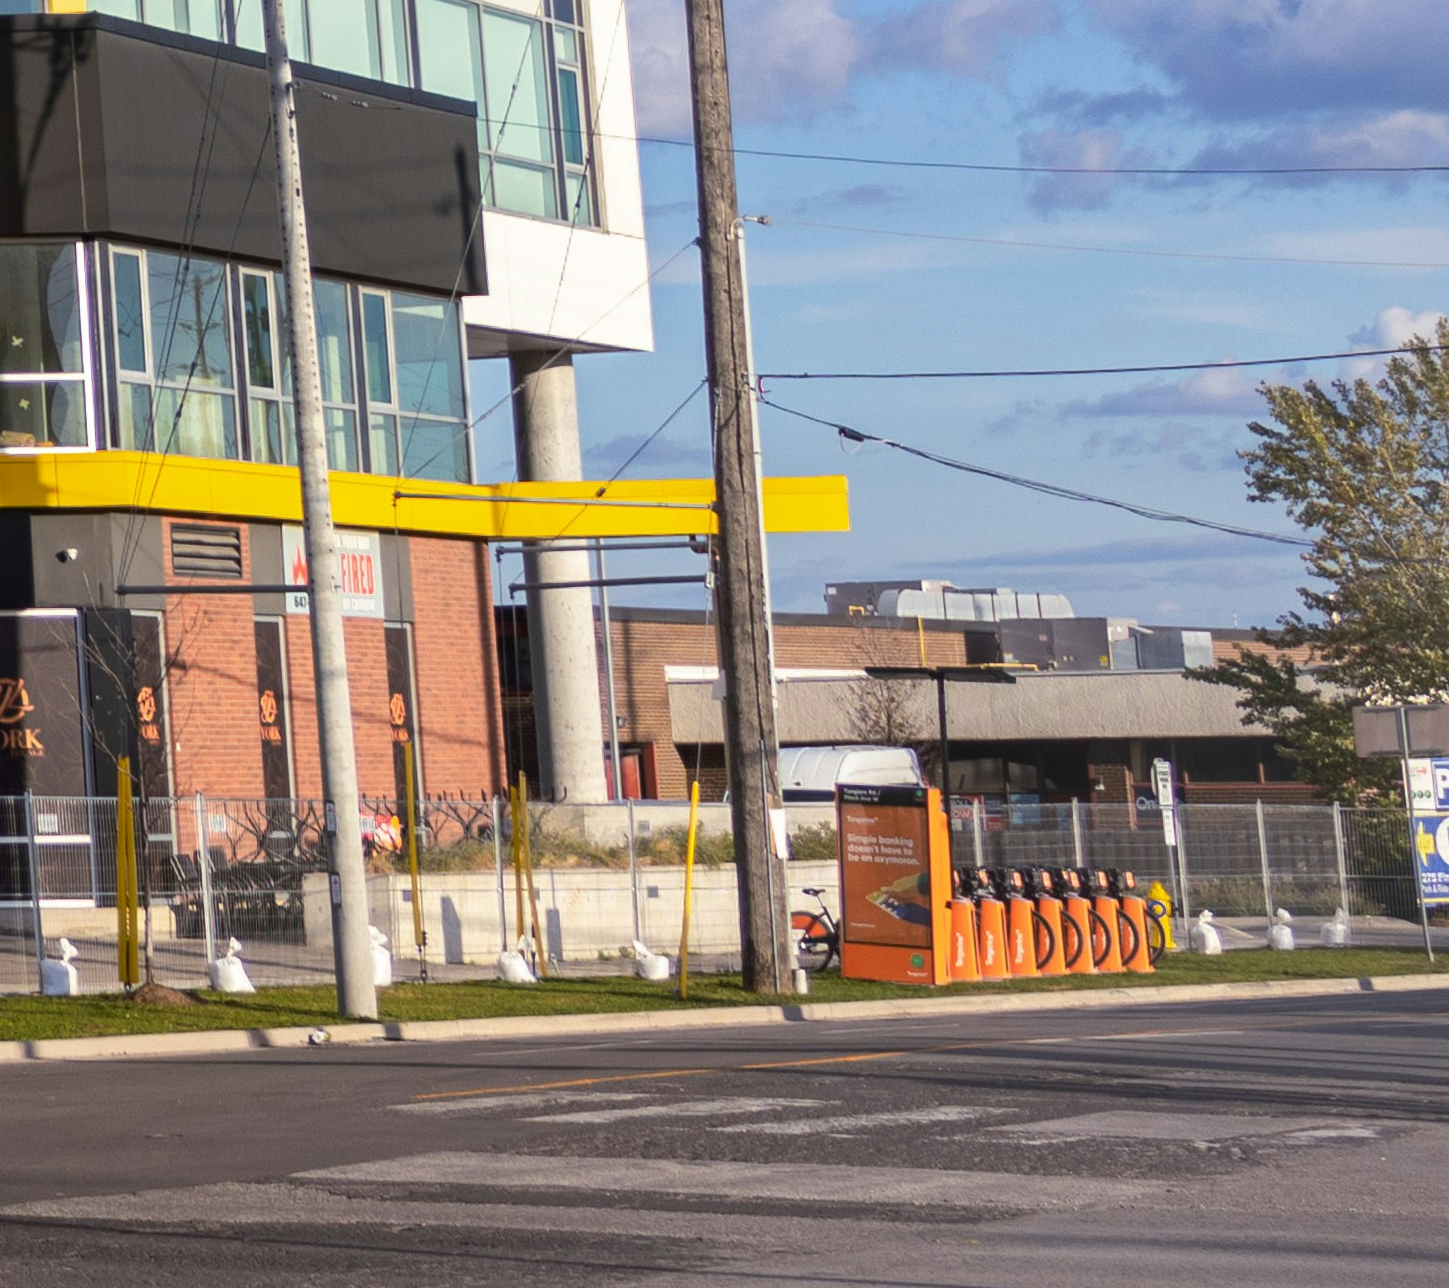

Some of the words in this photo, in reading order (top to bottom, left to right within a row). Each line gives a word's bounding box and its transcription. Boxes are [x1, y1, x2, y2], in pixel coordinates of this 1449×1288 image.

[340, 553, 374, 595] FIRED
[847, 833, 877, 844] Simple
[878, 835, 914, 848] banking
[847, 843, 880, 853] doesn't
[880, 845, 902, 855] have
[903, 847, 913, 856] to
[847, 853, 860, 862] be
[860, 854, 873, 862] an
